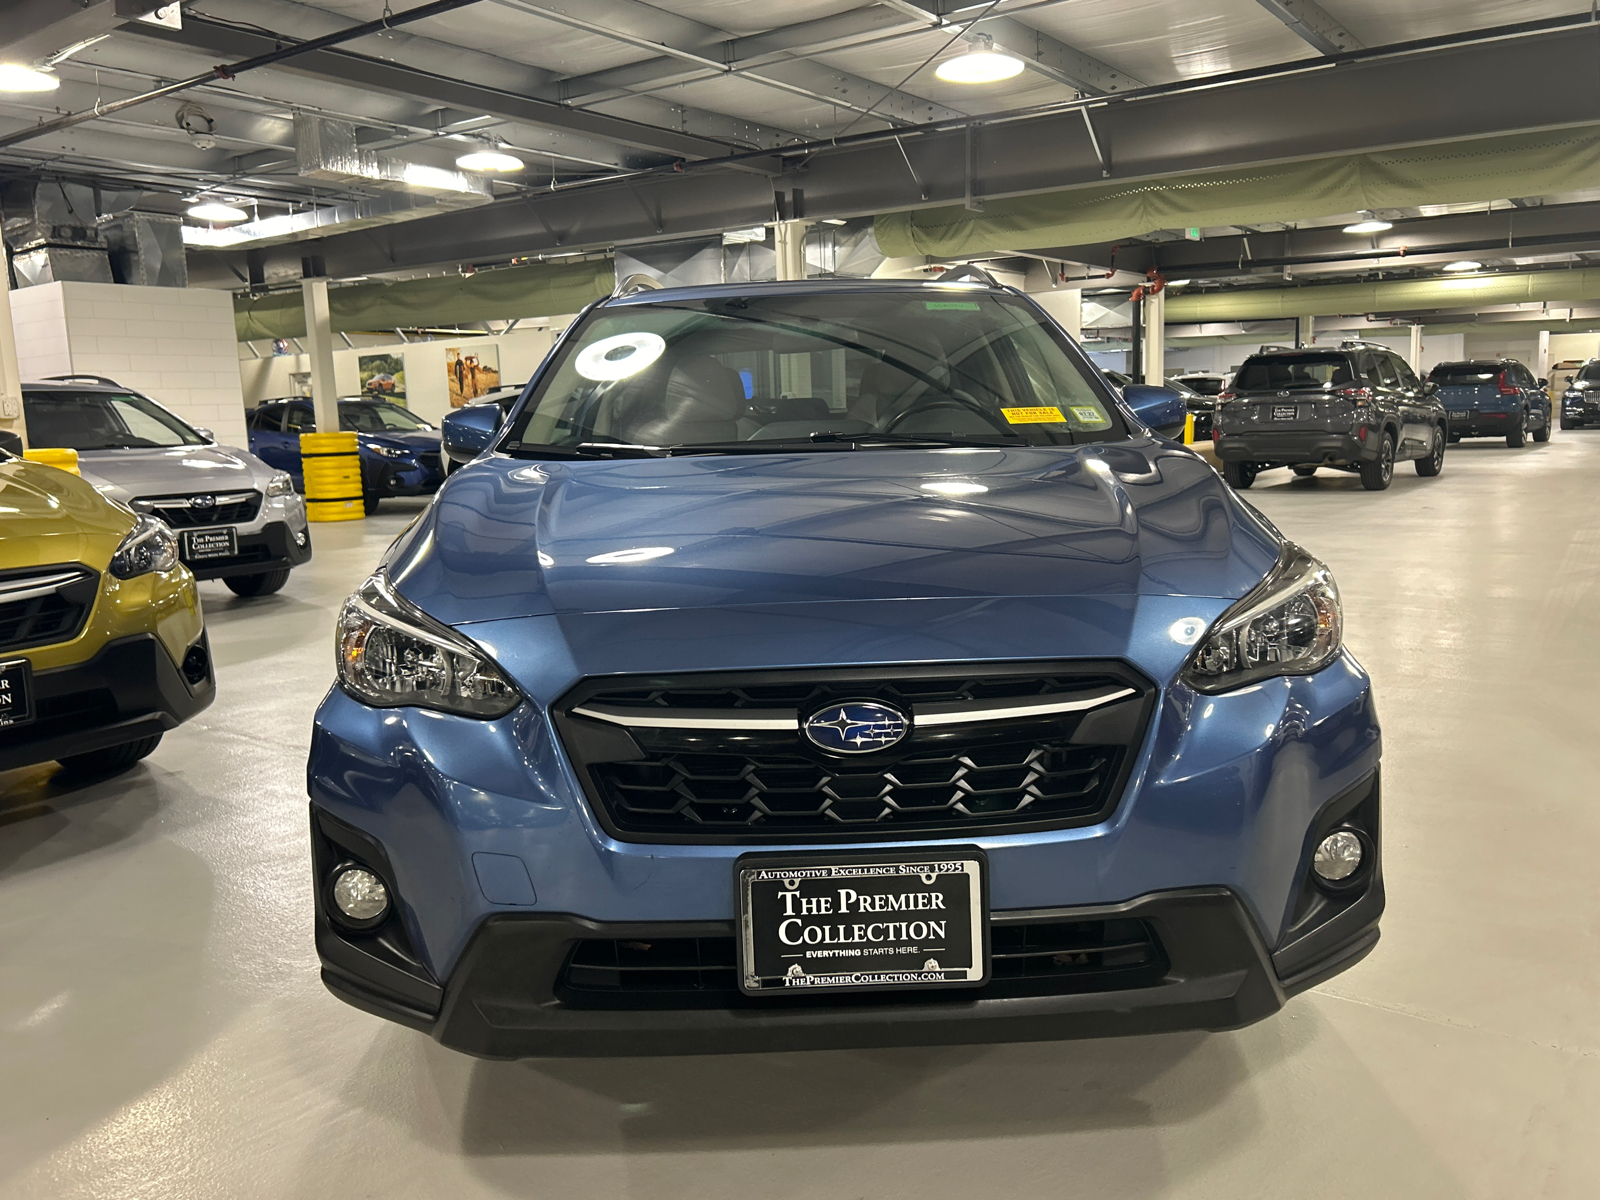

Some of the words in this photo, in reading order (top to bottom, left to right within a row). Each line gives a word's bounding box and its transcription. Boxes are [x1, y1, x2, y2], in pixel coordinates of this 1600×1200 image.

[192, 541, 229, 550] COLLECTION
[758, 869, 828, 880] AUTOMOTIVE
[830, 866, 897, 877] EXCELLENCE
[898, 864, 930, 875] SINCE
[933, 862, 963, 873] 1995
[777, 890, 834, 917] THE
[837, 888, 947, 915] PREMIER
[777, 918, 947, 946] COLLECTION
[805, 948, 862, 959] EVERYTHING
[863, 947, 895, 957] STARTS
[895, 945, 922, 955] HERE.
